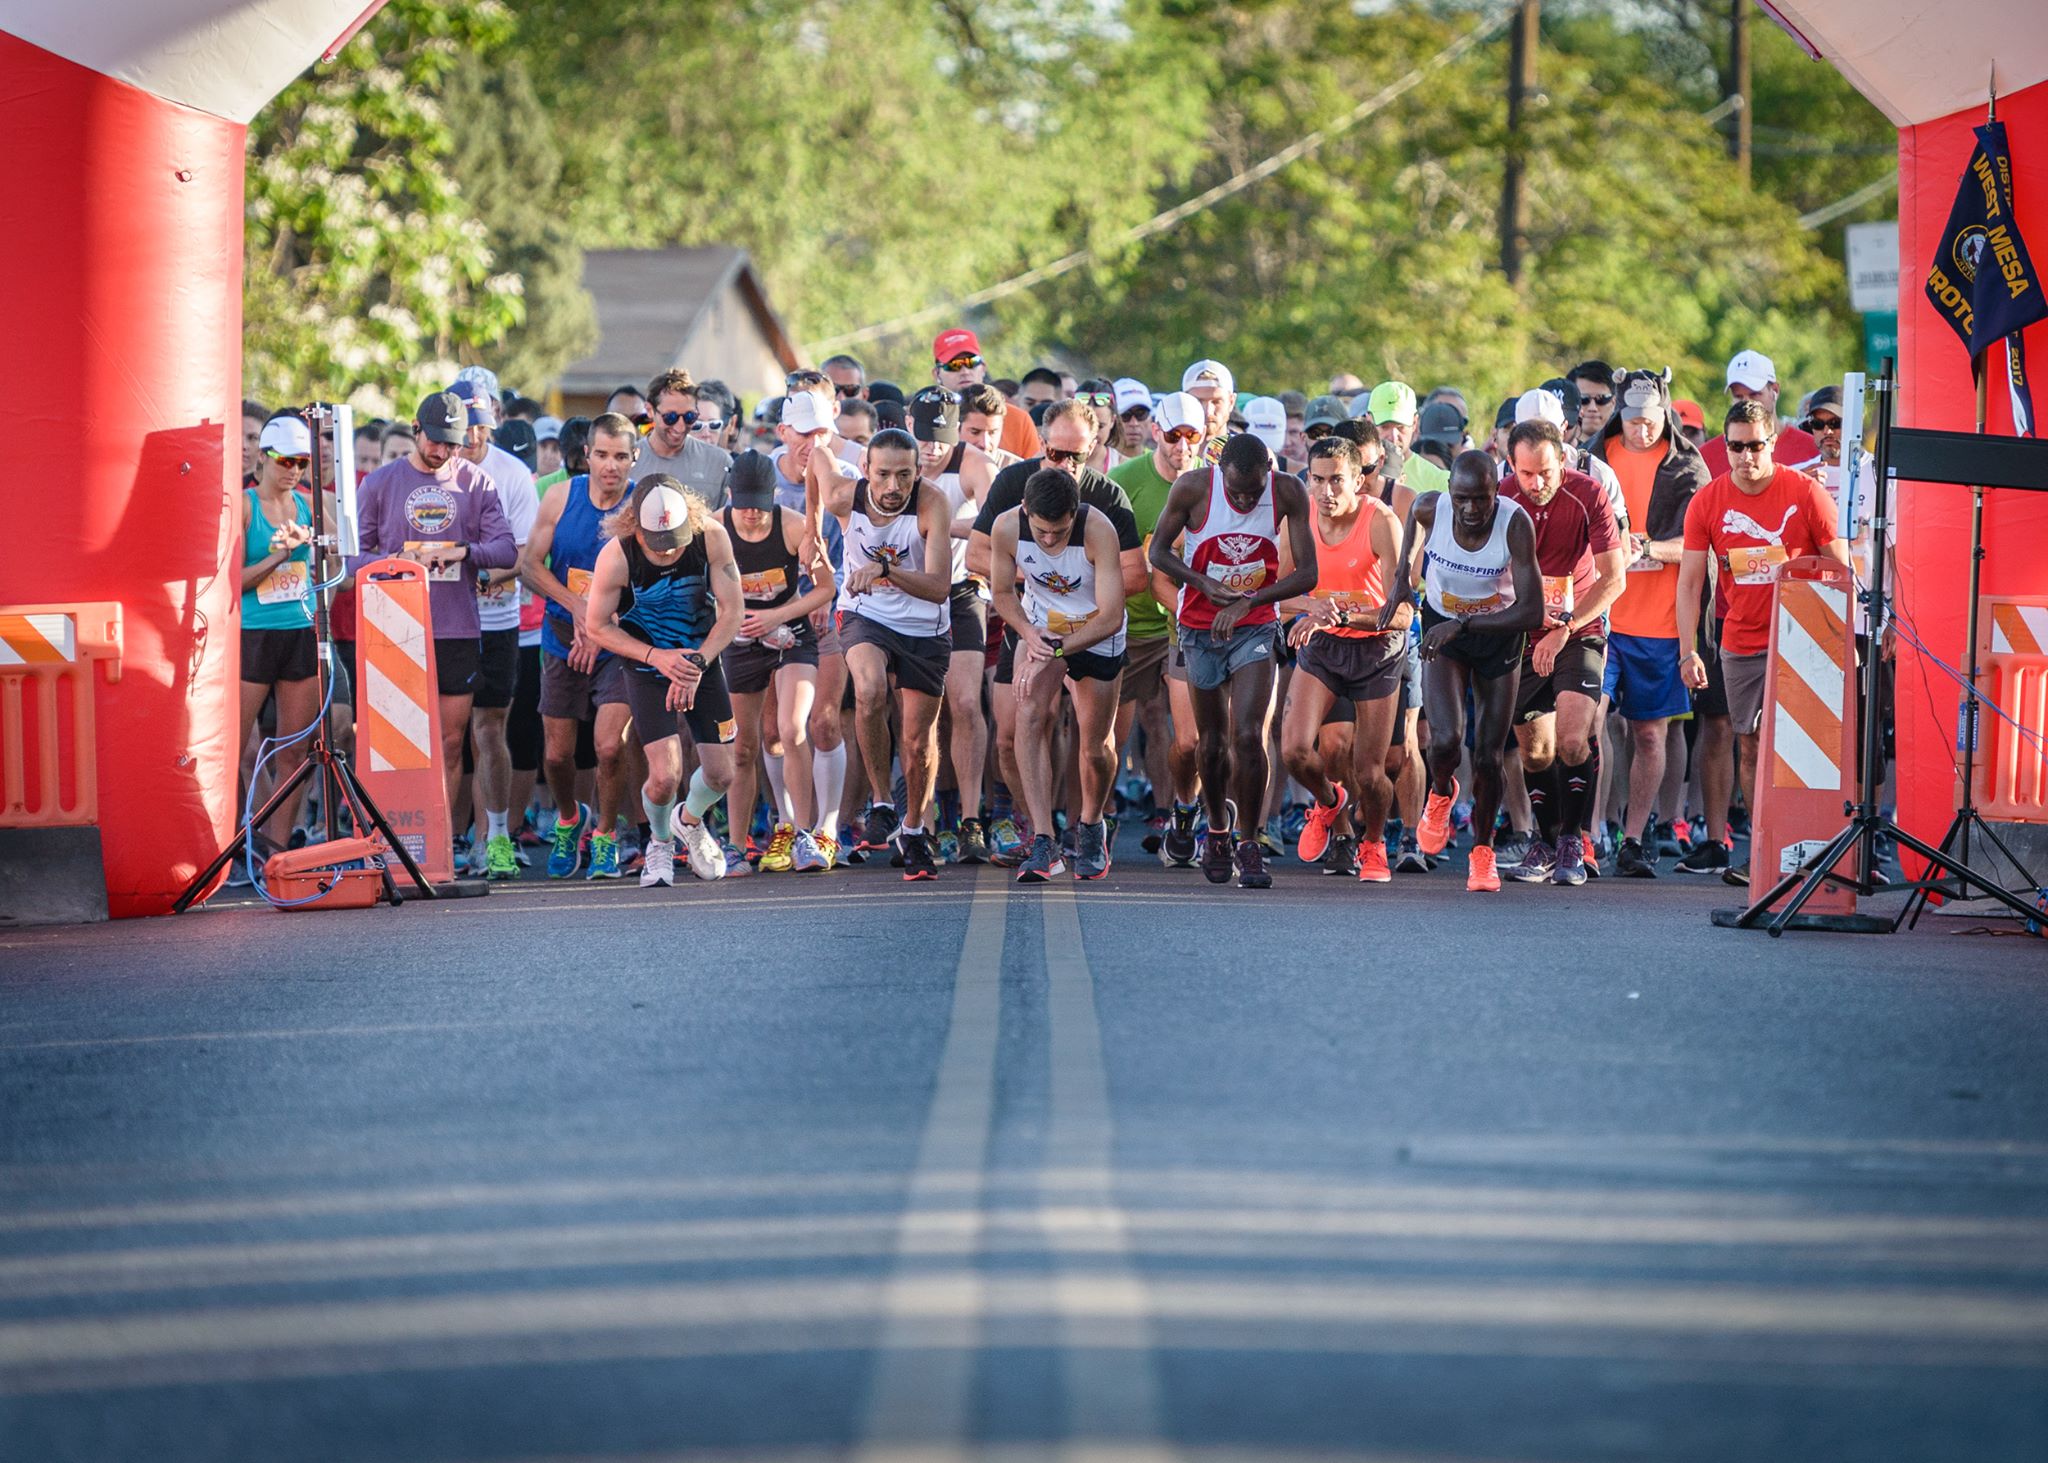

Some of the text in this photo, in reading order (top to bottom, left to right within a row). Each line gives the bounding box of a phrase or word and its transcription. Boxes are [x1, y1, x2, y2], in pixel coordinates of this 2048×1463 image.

[1973, 152, 2029, 299] WEST MESA
[2011, 347, 2024, 386] 2017
[1747, 559, 1770, 578] 95
[271, 574, 300, 592] 189
[1454, 602, 1491, 613] 565
